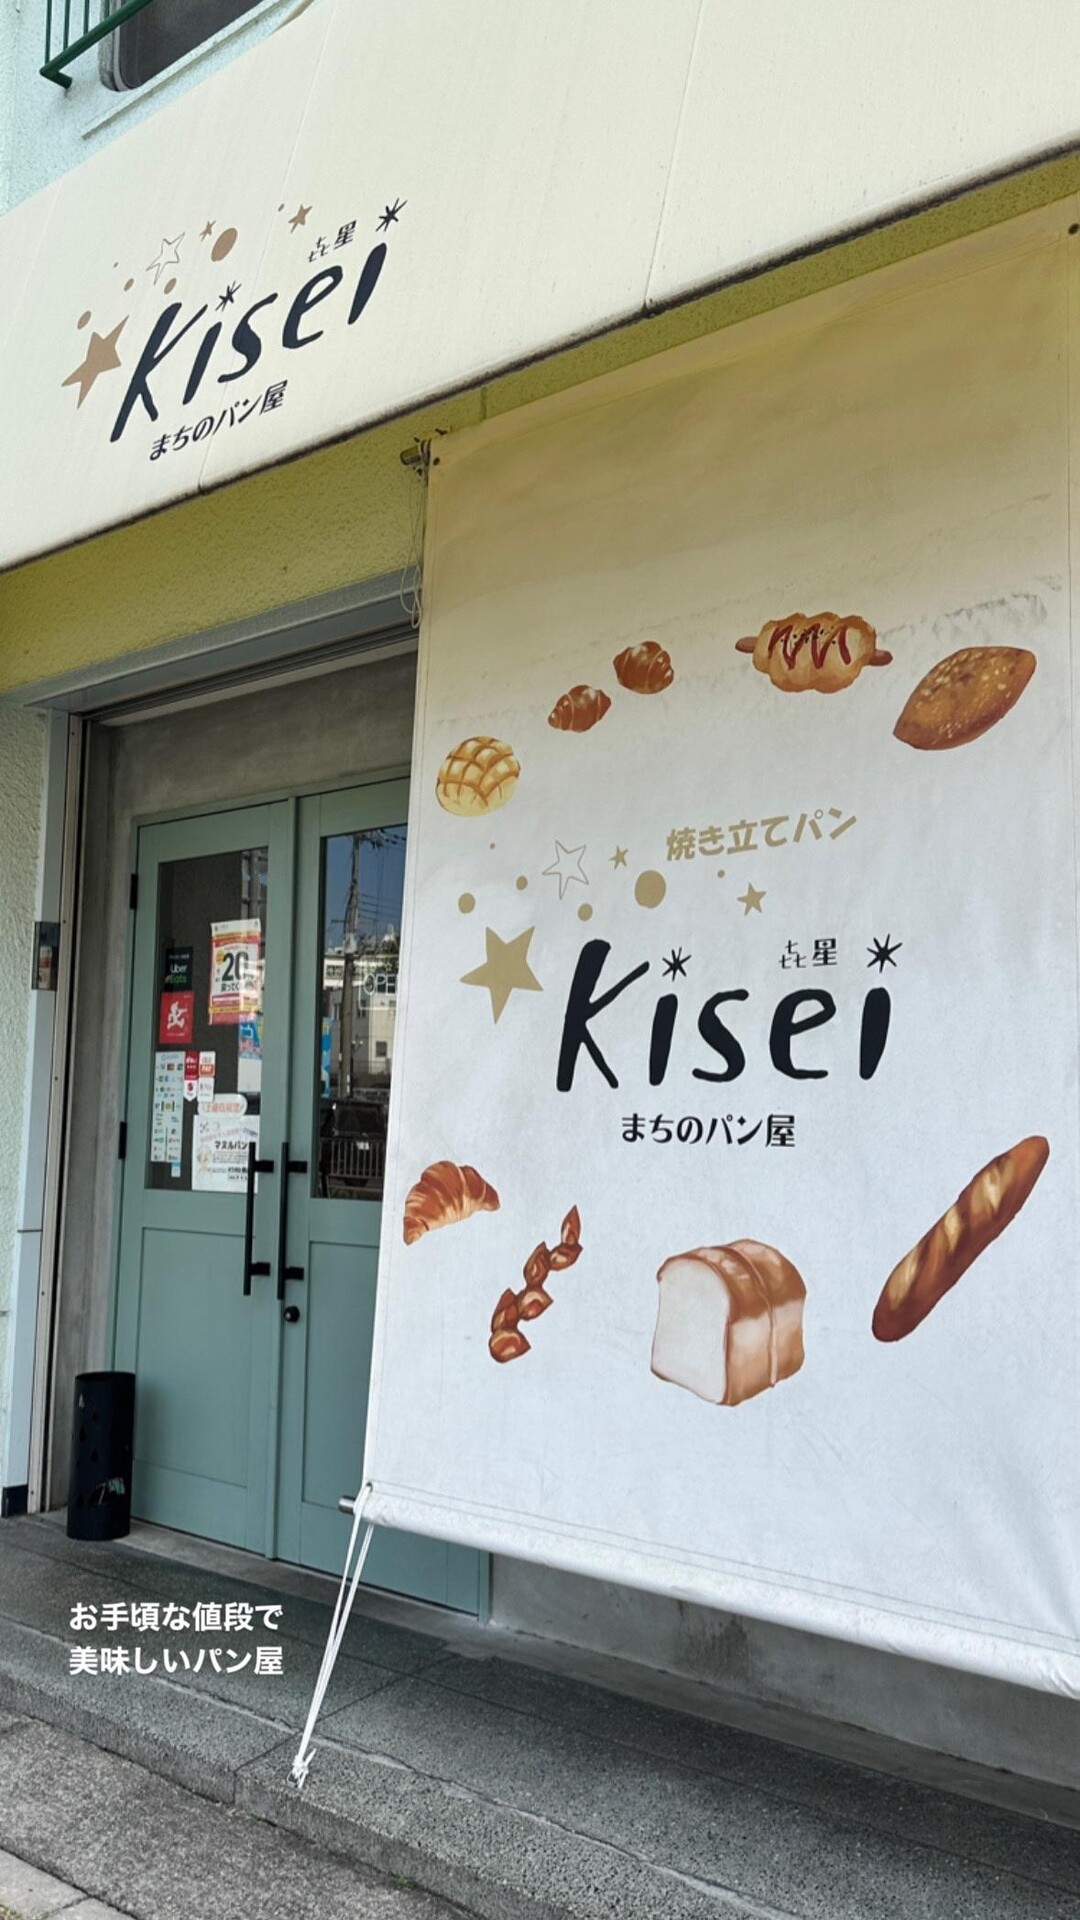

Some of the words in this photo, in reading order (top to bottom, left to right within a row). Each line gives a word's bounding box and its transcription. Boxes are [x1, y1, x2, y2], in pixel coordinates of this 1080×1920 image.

[149, 380, 288, 461] まちのパン屋
[666, 806, 857, 861] 焼き立てパン
[169, 963, 188, 974] Uber
[362, 973, 396, 996] OPE
[621, 1112, 797, 1149] まちのパン屋
